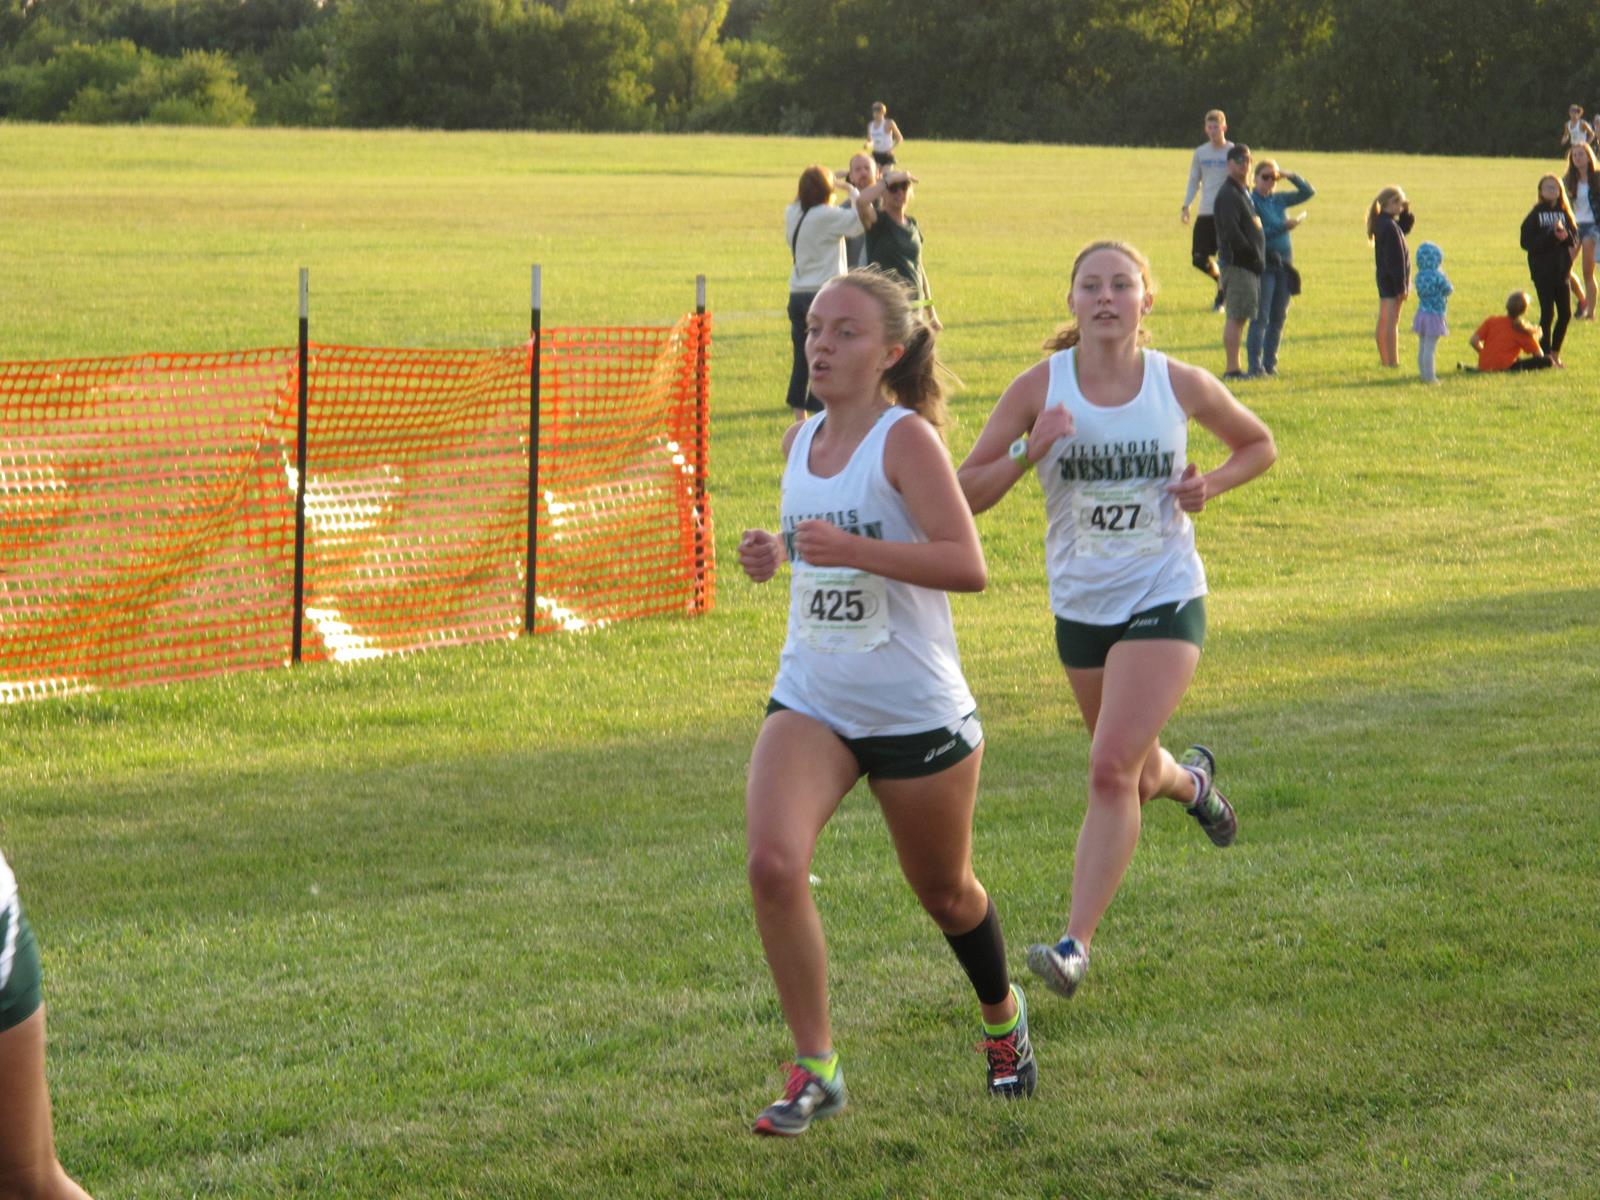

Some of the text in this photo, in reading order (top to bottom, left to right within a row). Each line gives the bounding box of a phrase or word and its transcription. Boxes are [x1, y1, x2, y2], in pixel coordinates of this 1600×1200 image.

[1071, 439, 1159, 458] ILLINOIS
[1058, 451, 1175, 481] WESLEYAN
[783, 509, 859, 530] ILOIS
[1091, 505, 1141, 531] 427
[810, 589, 865, 622] 425
